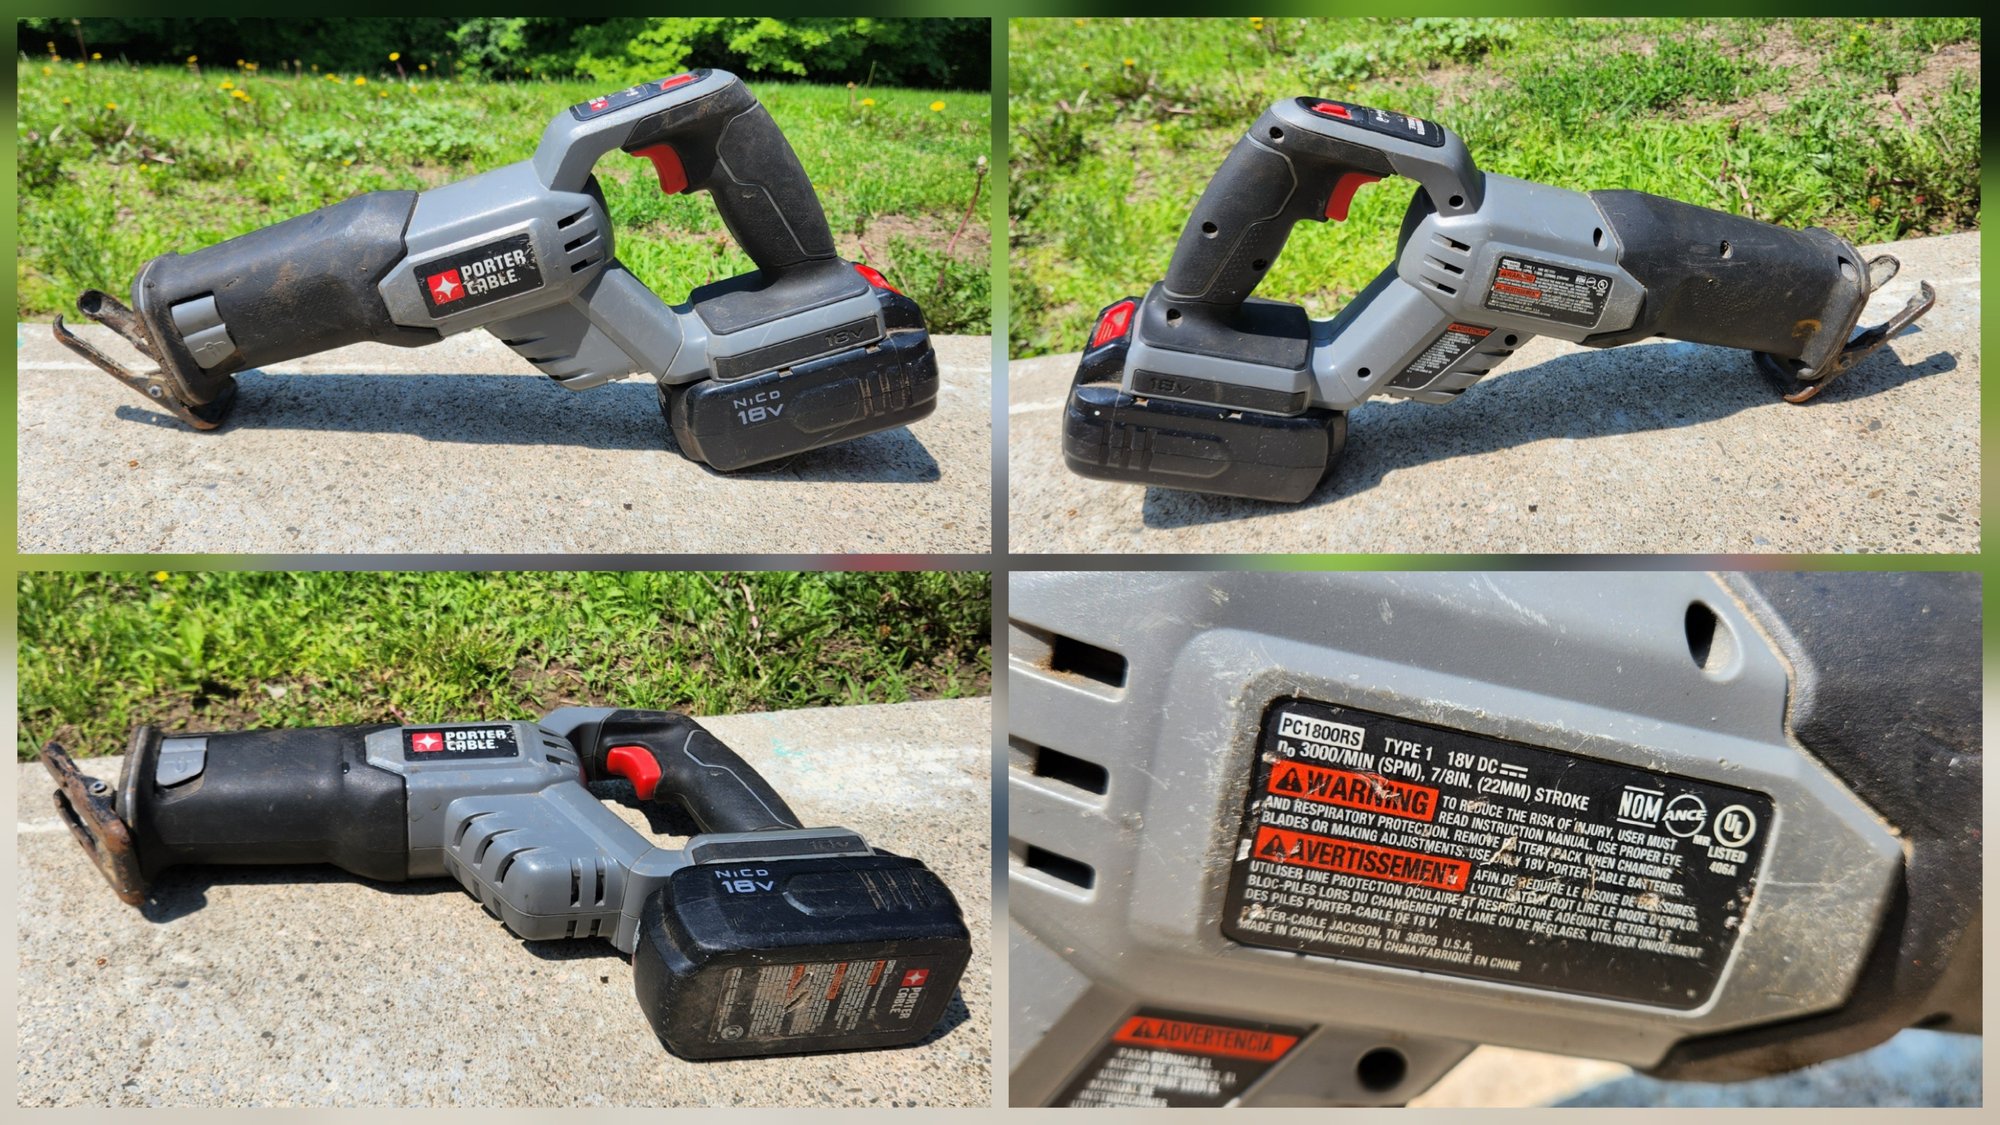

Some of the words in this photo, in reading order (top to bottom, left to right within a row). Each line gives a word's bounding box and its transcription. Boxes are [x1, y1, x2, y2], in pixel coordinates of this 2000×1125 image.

[460, 249, 526, 281] PORTER
[464, 268, 518, 295] CABLE
[824, 326, 864, 347] 18V
[738, 403, 784, 425] 18V
[445, 729, 506, 741] PORTER
[446, 739, 496, 752] CABLE
[1281, 717, 1361, 746] PC1800RS
[1382, 737, 1421, 759] TYPE
[1424, 745, 1433, 761] 1
[1446, 750, 1475, 770] 18V
[1476, 756, 1499, 774] DC
[1298, 741, 1375, 769] 3000/MIN
[1376, 756, 1427, 783] (SPM),
[1429, 766, 1474, 788] 7/8IN.
[1475, 775, 1532, 803] (22MM)
[1533, 786, 1590, 811] STROKE
[1304, 770, 1430, 816] WARNING
[1618, 791, 1663, 822] NOM
[1661, 810, 1708, 821] ANCE
[1263, 794, 1291, 811] AND
[1292, 799, 1375, 826] RESPIRATORY
[1376, 814, 1451, 840] PROTECTION.
[1453, 828, 1500, 848] REMOVE
[1551, 847, 1582, 863] PACK
[1584, 853, 1615, 870] WHEN
[1616, 859, 1672, 880] CHANGING
[1441, 795, 1457, 810] TO
[1458, 798, 1504, 819] REDUCE
[1505, 807, 1527, 823] THE
[1528, 811, 1555, 828] RISK
[1556, 816, 1572, 831] OF
[1573, 820, 1615, 840] INJURY,
[1616, 828, 1645, 845] USER
[1646, 834, 1678, 851] MUST
[1724, 814, 1744, 840] UL
[1261, 810, 1309, 830] BLADES
[1310, 819, 1329, 833] OR
[1330, 822, 1378, 842] MAKING
[1379, 831, 1466, 858] ADJUSTMENTS.
[1468, 847, 1491, 862] USE
[1523, 857, 1544, 871] 18V
[1546, 861, 1626, 886] PORTER-CABLE
[1626, 875, 1686, 896] BATTERIES.
[1438, 811, 1469, 827] READ
[1470, 816, 1545, 841] INSTRUCTION
[1545, 830, 1594, 850] MANUAL.
[1595, 840, 1619, 856] USE
[1618, 844, 1662, 863] PROPER
[1661, 852, 1683, 867] EYE
[1706, 845, 1748, 864] LISTED
[1289, 836, 1460, 887] AVERTISSEMENT
[722, 880, 774, 894] 18V
[1248, 860, 1304, 880] UTILISER
[1305, 869, 1330, 884] UNE
[1330, 873, 1402, 896] PROTECTION
[1404, 886, 1461, 906] OCULAIRE
[1460, 895, 1476, 909] ET
[1476, 898, 1554, 921] RESPIRATOIRE
[1613, 920, 1657, 939] RETIRER
[1657, 928, 1672, 942] LE
[1473, 868, 1499, 884] AFIN
[1500, 874, 1515, 887] DE
[1565, 885, 1579, 898] LE
[1580, 887, 1620, 905] RISQUE
[1620, 894, 1635, 908] DE
[1244, 887, 1269, 902] DES
[1269, 891, 1305, 908] PILES
[1305, 897, 1392, 922] PORTER-CABLE
[1394, 911, 1410, 925] DE
[1411, 914, 1426, 927] 18
[1428, 917, 1439, 930] V.
[1246, 873, 1317, 896] BLOC-PILES
[1318, 885, 1351, 902] LORS
[1351, 891, 1369, 905] DU
[1370, 894, 1446, 917] CHANGEMENT
[1448, 906, 1464, 920] DE
[1465, 909, 1497, 926] LAME
[1497, 915, 1514, 928] OU
[1515, 918, 1530, 931] DE
[1590, 930, 1637, 948] UTILISER
[1636, 937, 1703, 960] UNIQUEMENT
[1469, 882, 1548, 907] L'UTILISATEUR
[1549, 896, 1574, 911] DOIT
[1576, 900, 1600, 915] LIRE
[1600, 905, 1616, 918] LE
[1616, 908, 1648, 924] MODE
[1648, 913, 1699, 932] D'EMPLOI.
[1241, 904, 1328, 929] PTER-CABLE
[1328, 918, 1383, 939] JACKSON,
[1385, 928, 1400, 941] TN
[1405, 931, 1438, 947] 38305
[1237, 917, 1273, 933] MADE
[1273, 923, 1287, 936] IN
[1288, 925, 1364, 948] CHINA/HECHO
[1365, 937, 1382, 950] EN
[1472, 954, 1488, 967] EN
[1489, 956, 1521, 972] CHINE
[890, 988, 910, 1015] CABLE
[899, 987, 922, 1019] PORTER
[1156, 1022, 1273, 1053] ADVERTENCIA
[1107, 1058, 1150, 1073] RIESGO
[1150, 1062, 1166, 1075] DE
[1118, 1047, 1150, 1061] PARA
[1150, 1051, 1199, 1068] REDUCIR
[1200, 1057, 1212, 1068] EL
[1088, 1079, 1138, 1095] MANUAL
[1098, 1068, 1150, 1084] USUARIO
[1078, 1090, 1168, 1108] INSTRUCCIONES
